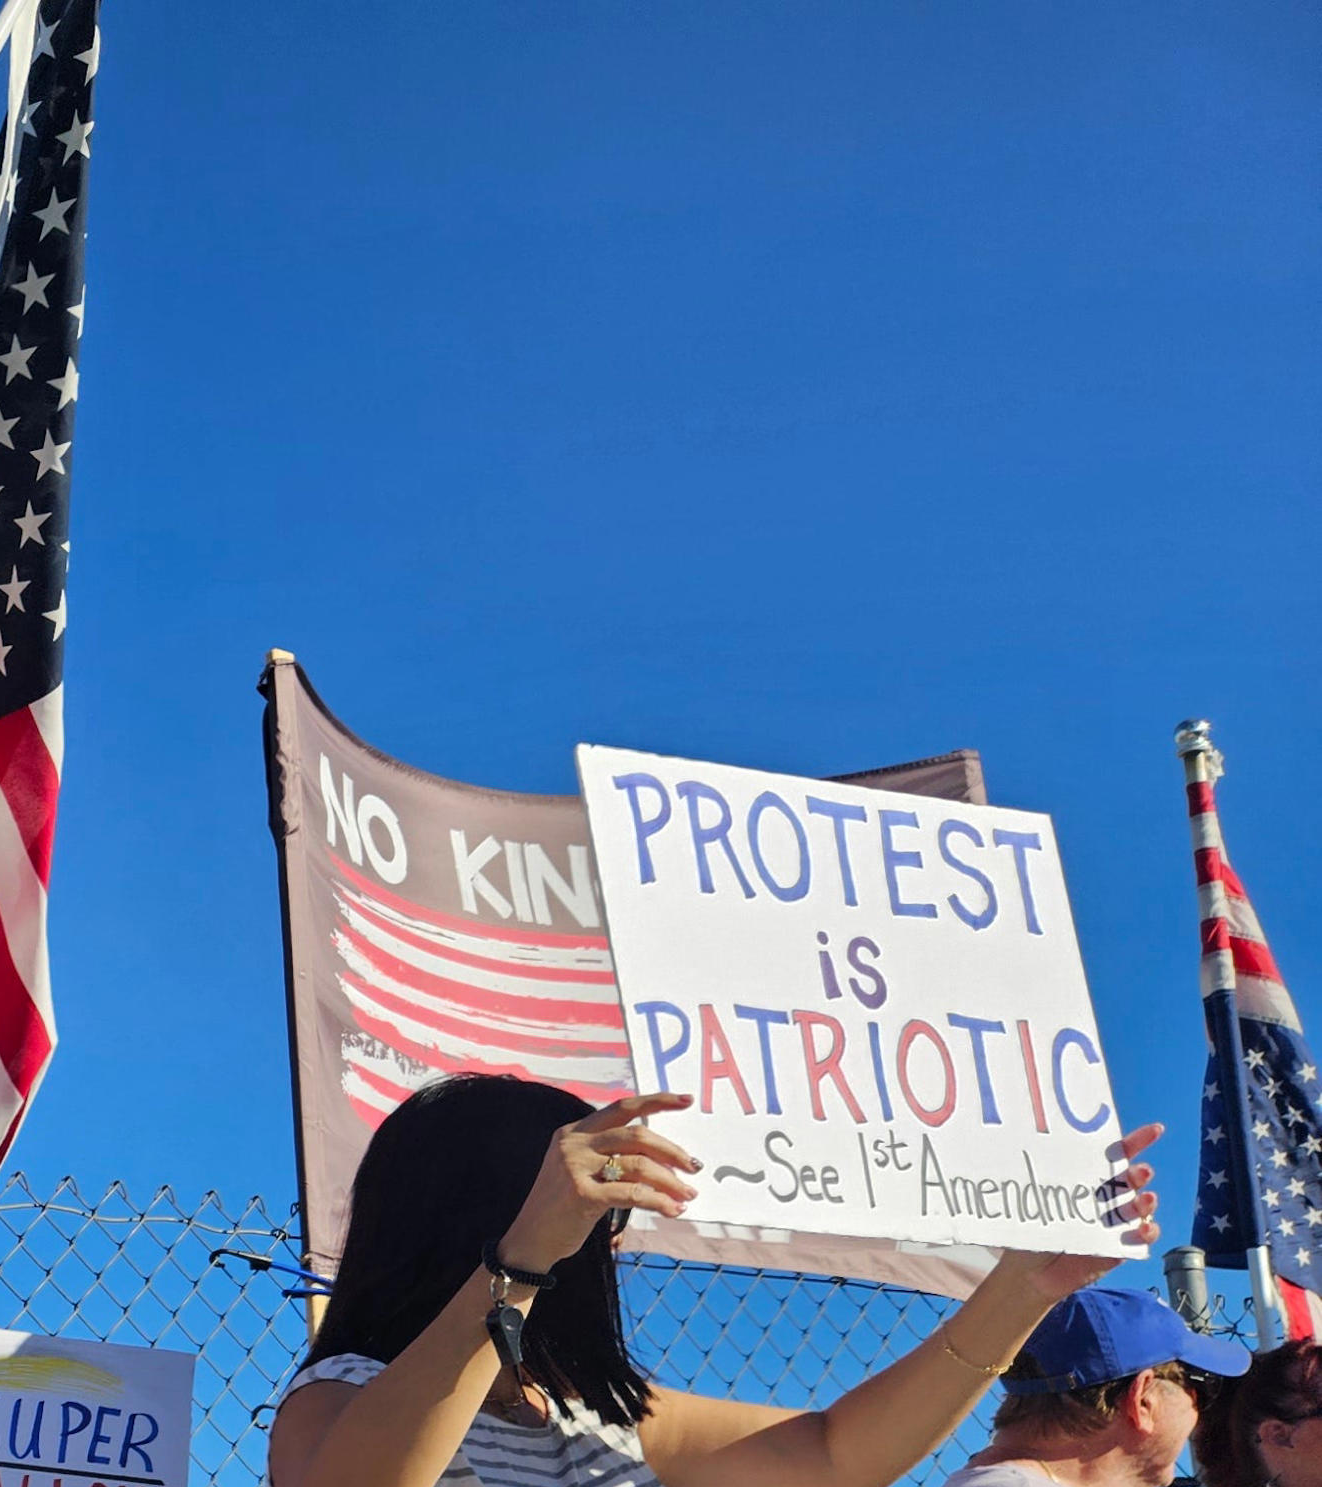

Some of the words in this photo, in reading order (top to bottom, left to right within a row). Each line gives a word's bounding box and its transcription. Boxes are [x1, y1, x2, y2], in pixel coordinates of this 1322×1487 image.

[319, 754, 408, 887] NO
[452, 829, 602, 928] KIN
[612, 771, 1045, 938] PROTEST
[634, 1000, 1111, 1135] PATRIOTIC
[921, 1151, 1130, 1229] Amendment
